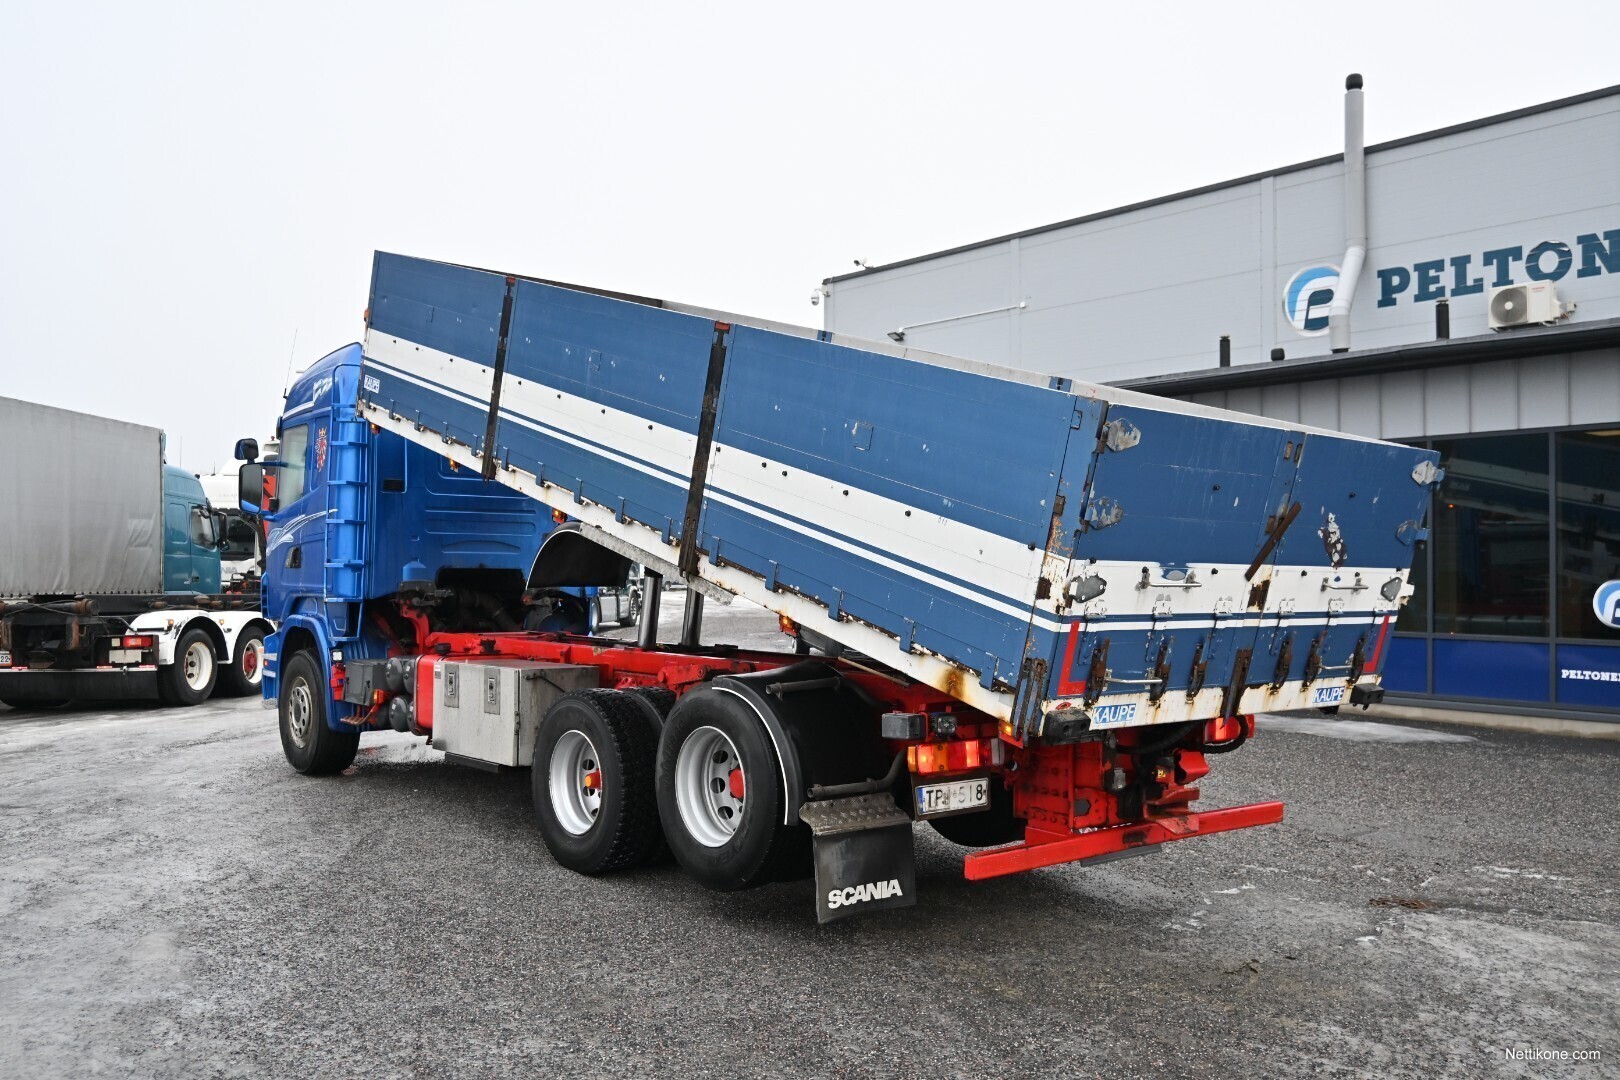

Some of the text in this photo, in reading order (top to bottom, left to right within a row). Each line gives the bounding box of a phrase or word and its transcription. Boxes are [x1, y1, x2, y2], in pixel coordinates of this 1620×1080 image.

[1561, 669, 1620, 682] PELTONE
[1313, 686, 1345, 703] KAUPE
[1093, 704, 1136, 724] KAUPE
[828, 879, 903, 909] SCANIA
